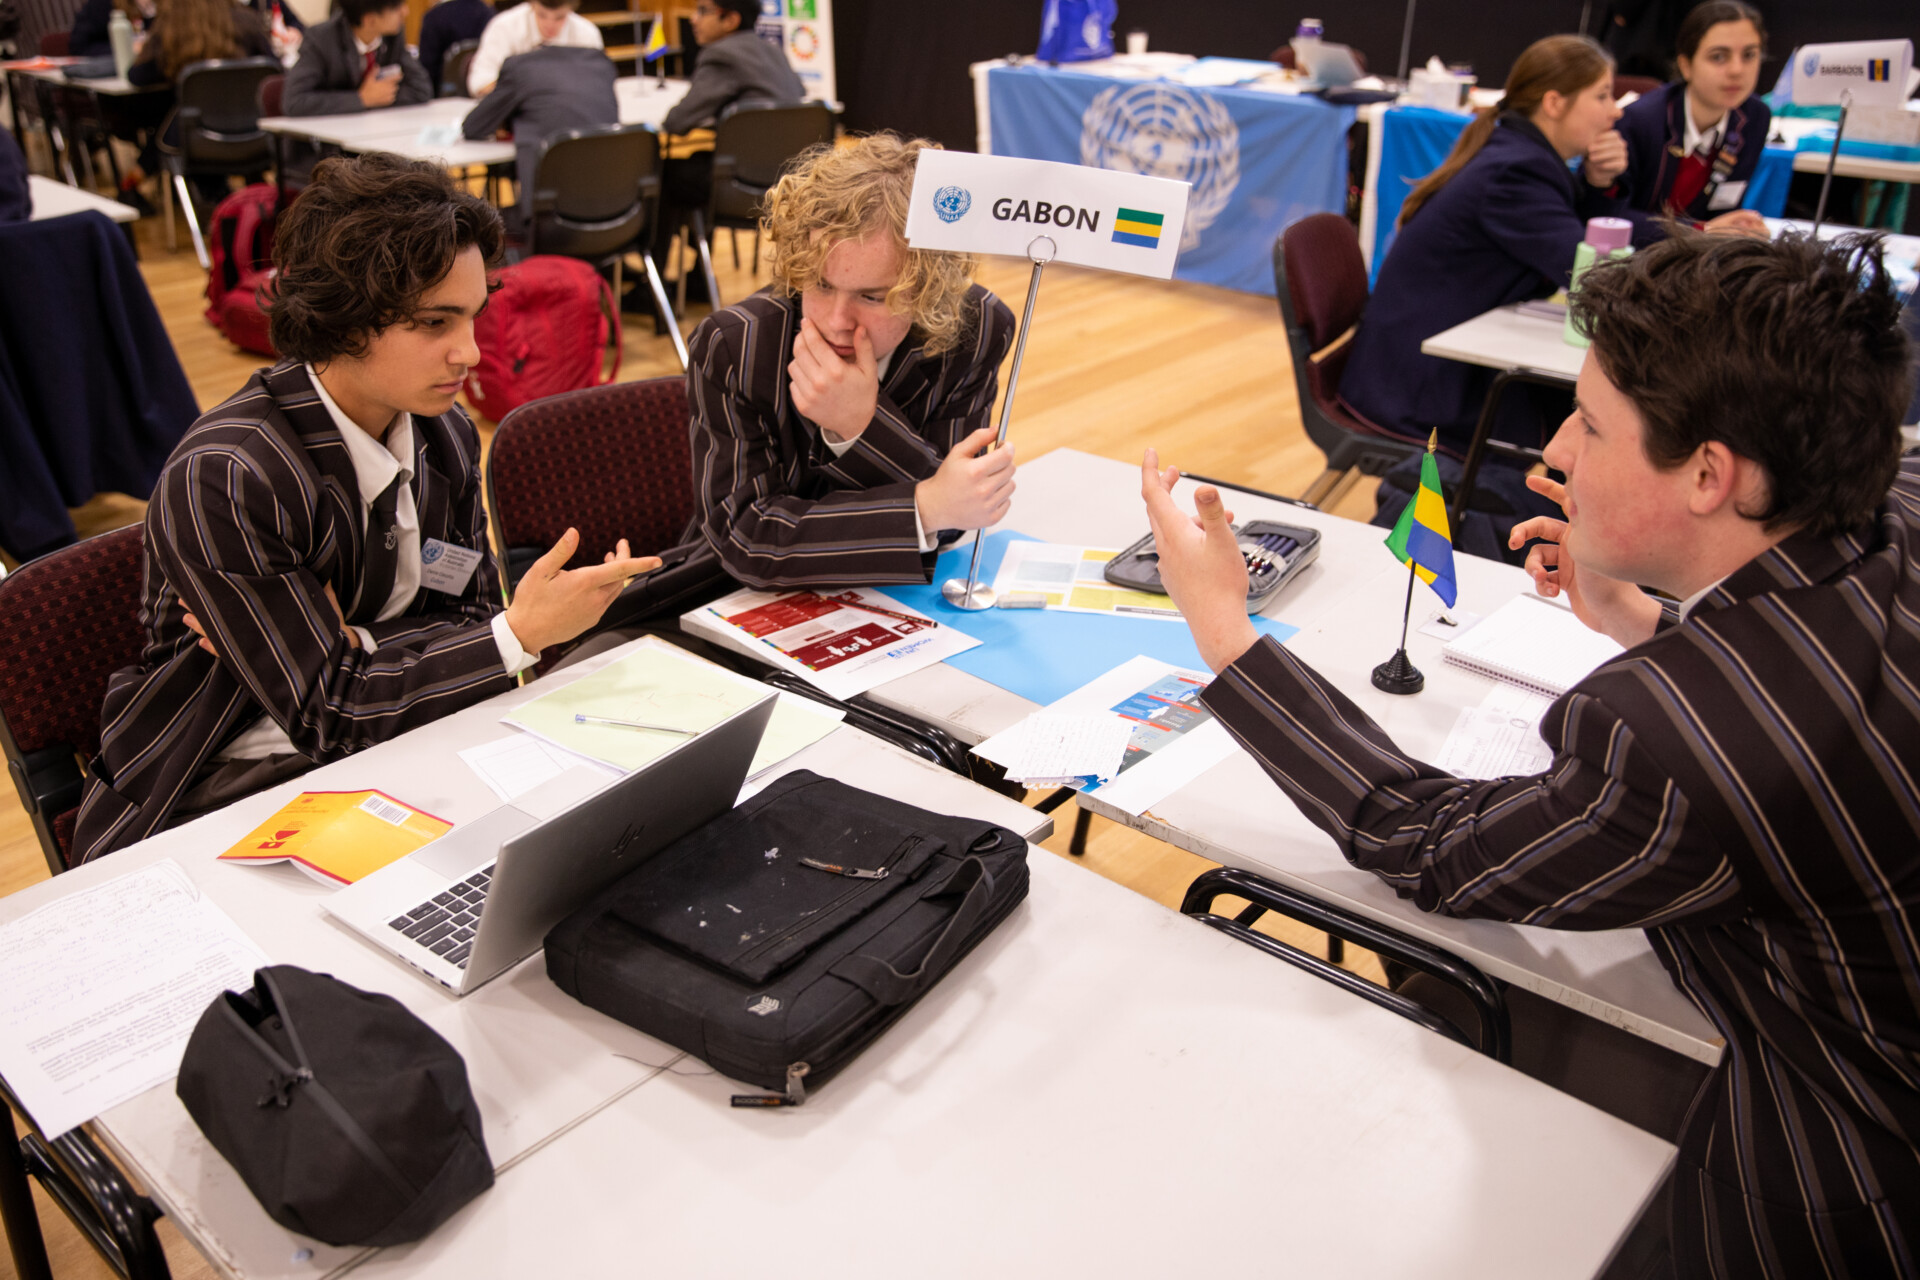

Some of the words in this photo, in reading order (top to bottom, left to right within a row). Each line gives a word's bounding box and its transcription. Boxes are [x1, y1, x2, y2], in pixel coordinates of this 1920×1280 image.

[1820, 65, 1864, 76] BARBADOS
[940, 212, 959, 221] UNAA
[992, 198, 1100, 232] GABON
